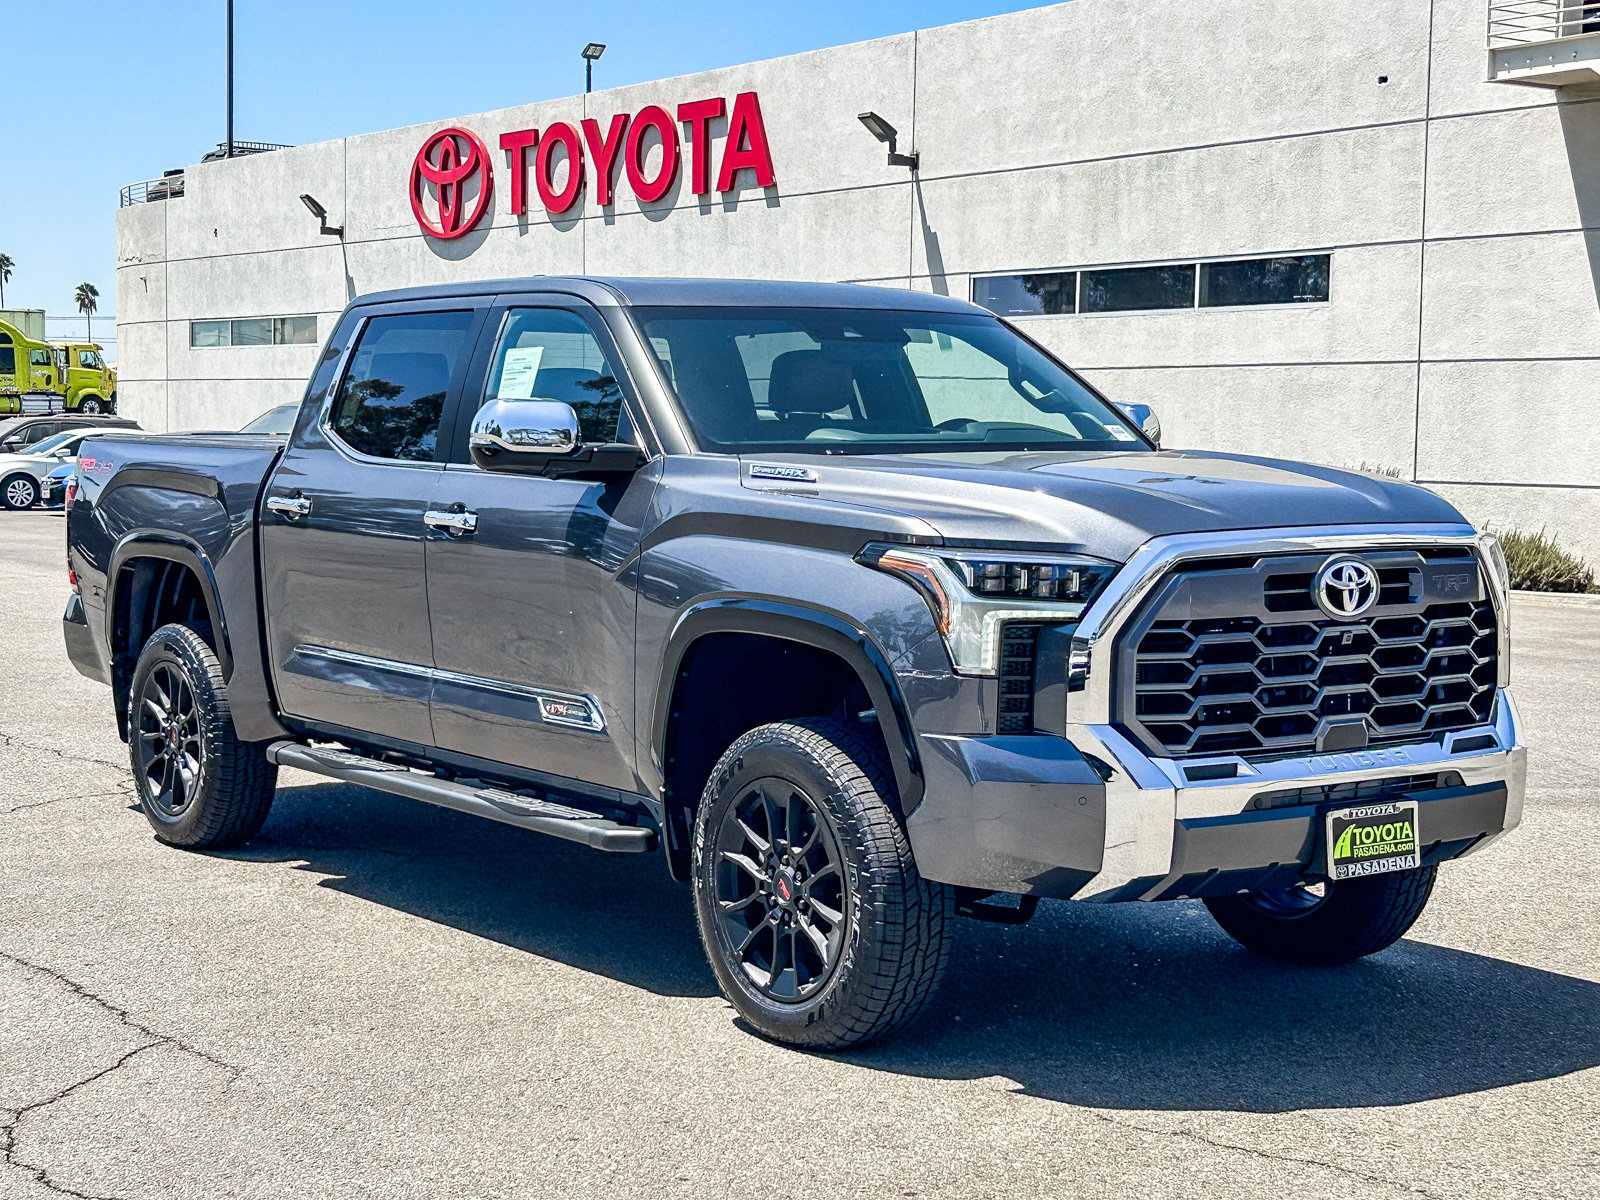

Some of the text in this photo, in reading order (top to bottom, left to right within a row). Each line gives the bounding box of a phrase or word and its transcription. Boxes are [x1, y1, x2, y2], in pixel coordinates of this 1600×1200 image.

[499, 91, 777, 216] TOYOTA
[1305, 749, 1413, 772] TUNDRA
[1351, 805, 1395, 817] TOYOTA
[1354, 821, 1412, 845] TOYOTA
[1354, 843, 1414, 858] PASADENA.com
[1348, 856, 1415, 877] PASADENA
